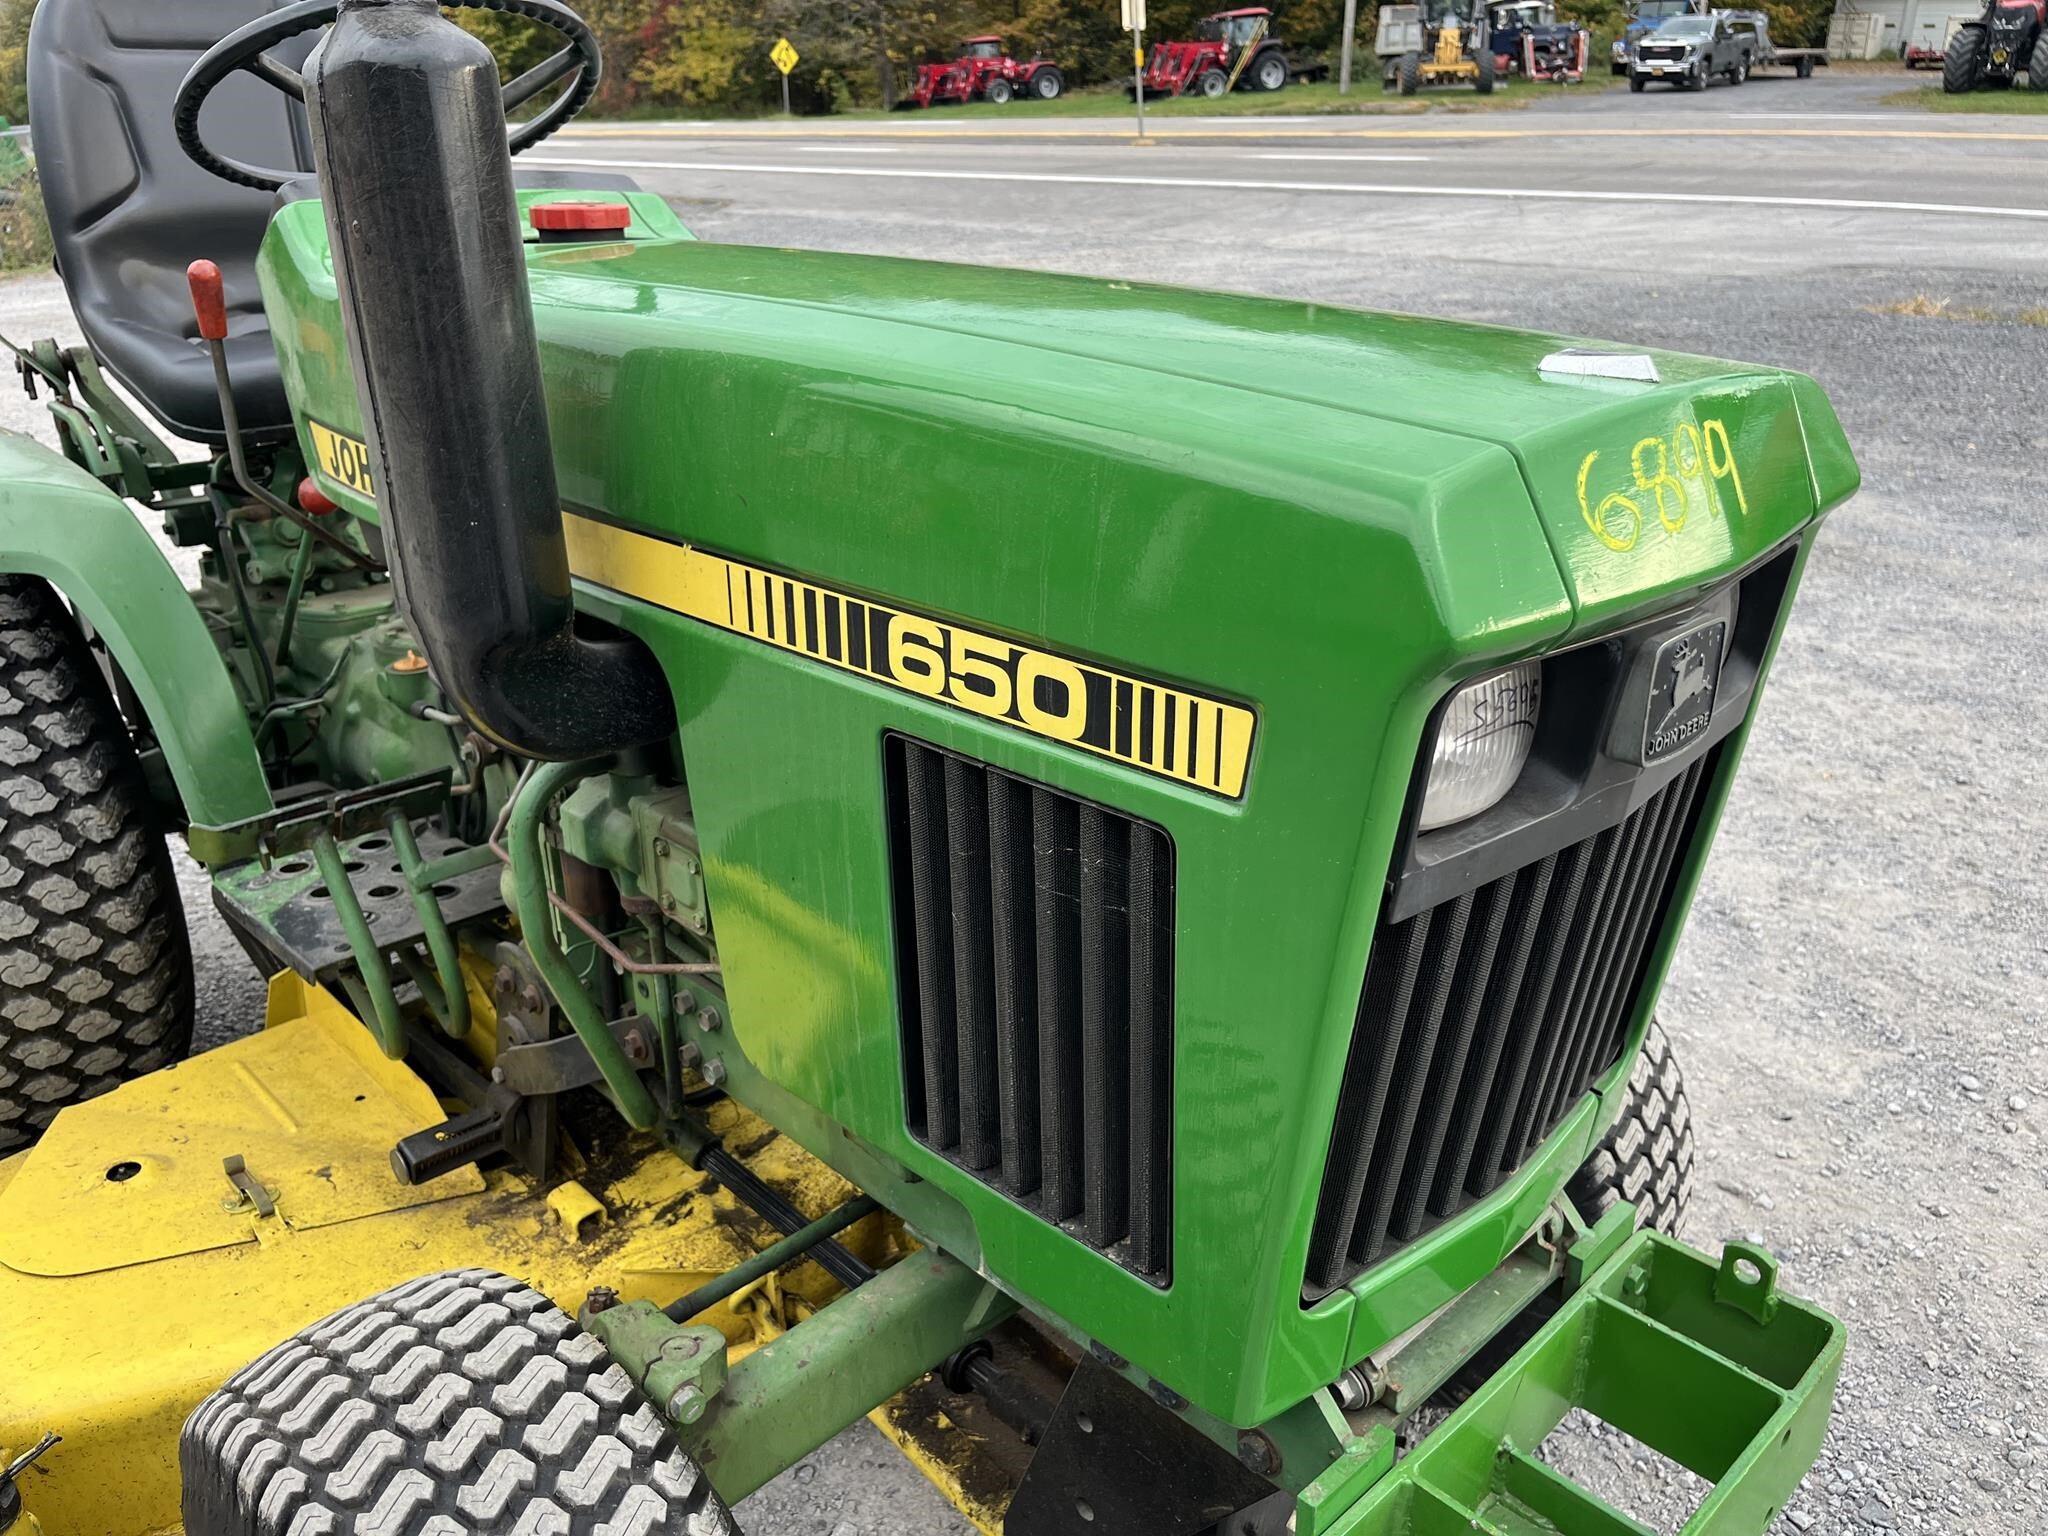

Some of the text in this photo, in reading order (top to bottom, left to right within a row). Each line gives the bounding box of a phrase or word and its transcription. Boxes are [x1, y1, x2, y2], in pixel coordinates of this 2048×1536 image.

[330, 434, 376, 494] JOH
[1577, 419, 1748, 552] 6899
[888, 614, 1087, 741] 650
[1647, 711, 1710, 756] JOHN DEERE
